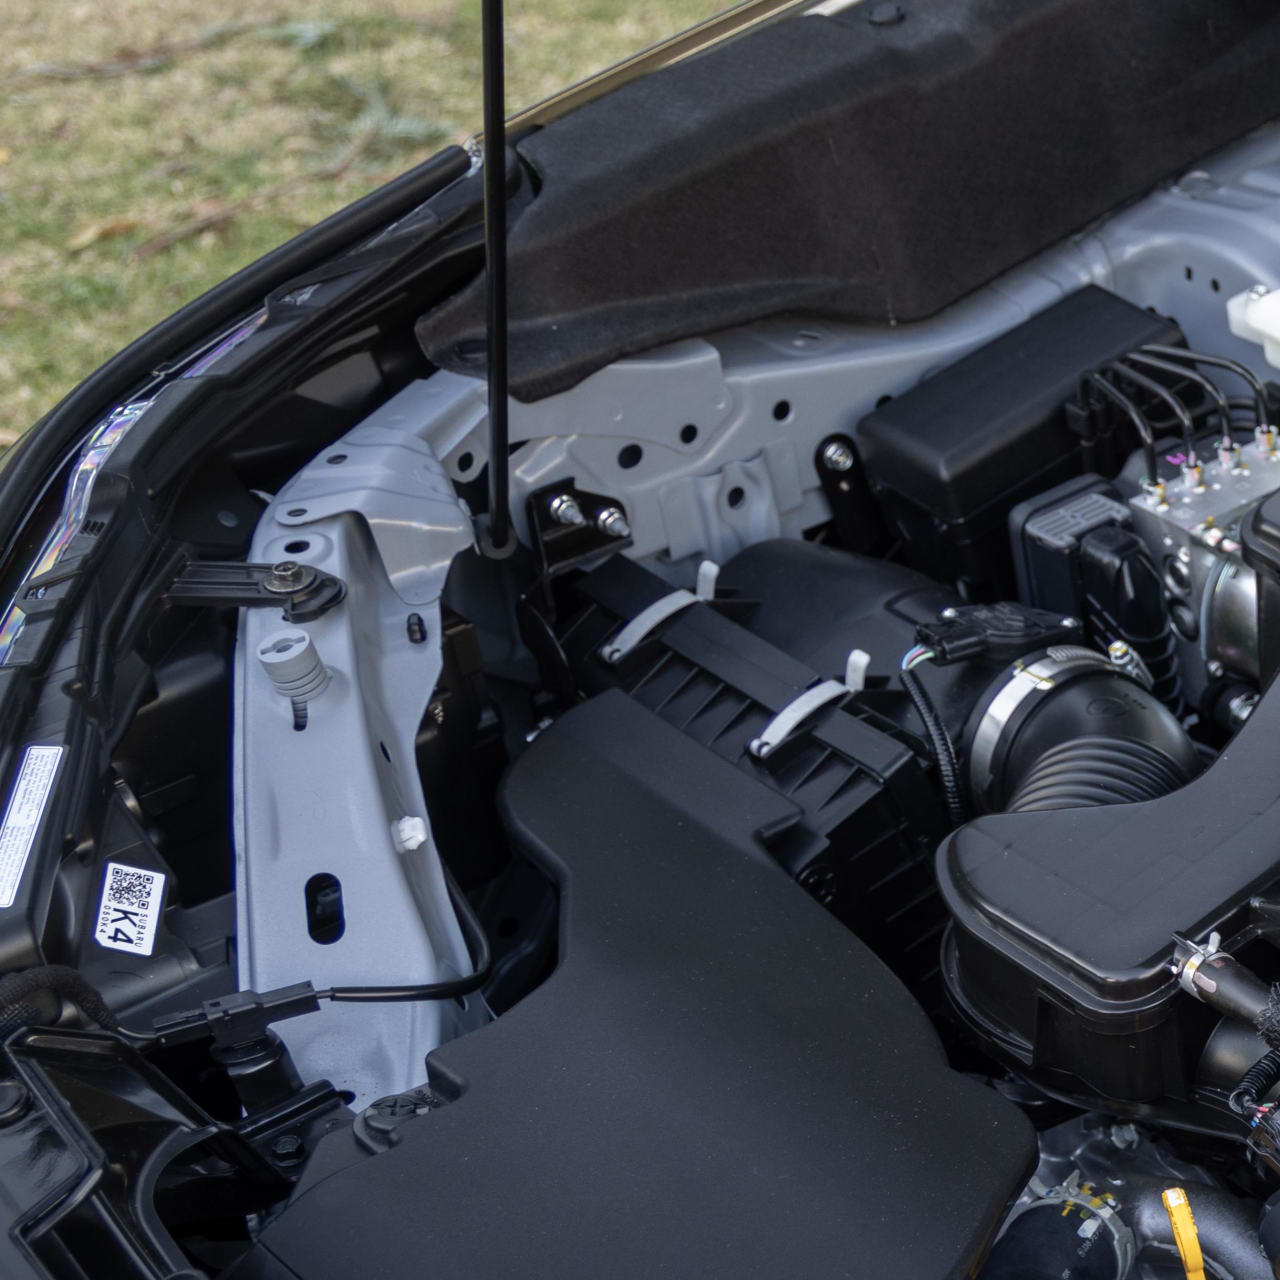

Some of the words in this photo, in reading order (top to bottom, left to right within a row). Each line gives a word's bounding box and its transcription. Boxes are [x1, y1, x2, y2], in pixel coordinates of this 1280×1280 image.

[99, 905, 111, 934] 050K4
[108, 908, 139, 944] K4
[134, 913, 148, 947] SUBARU
